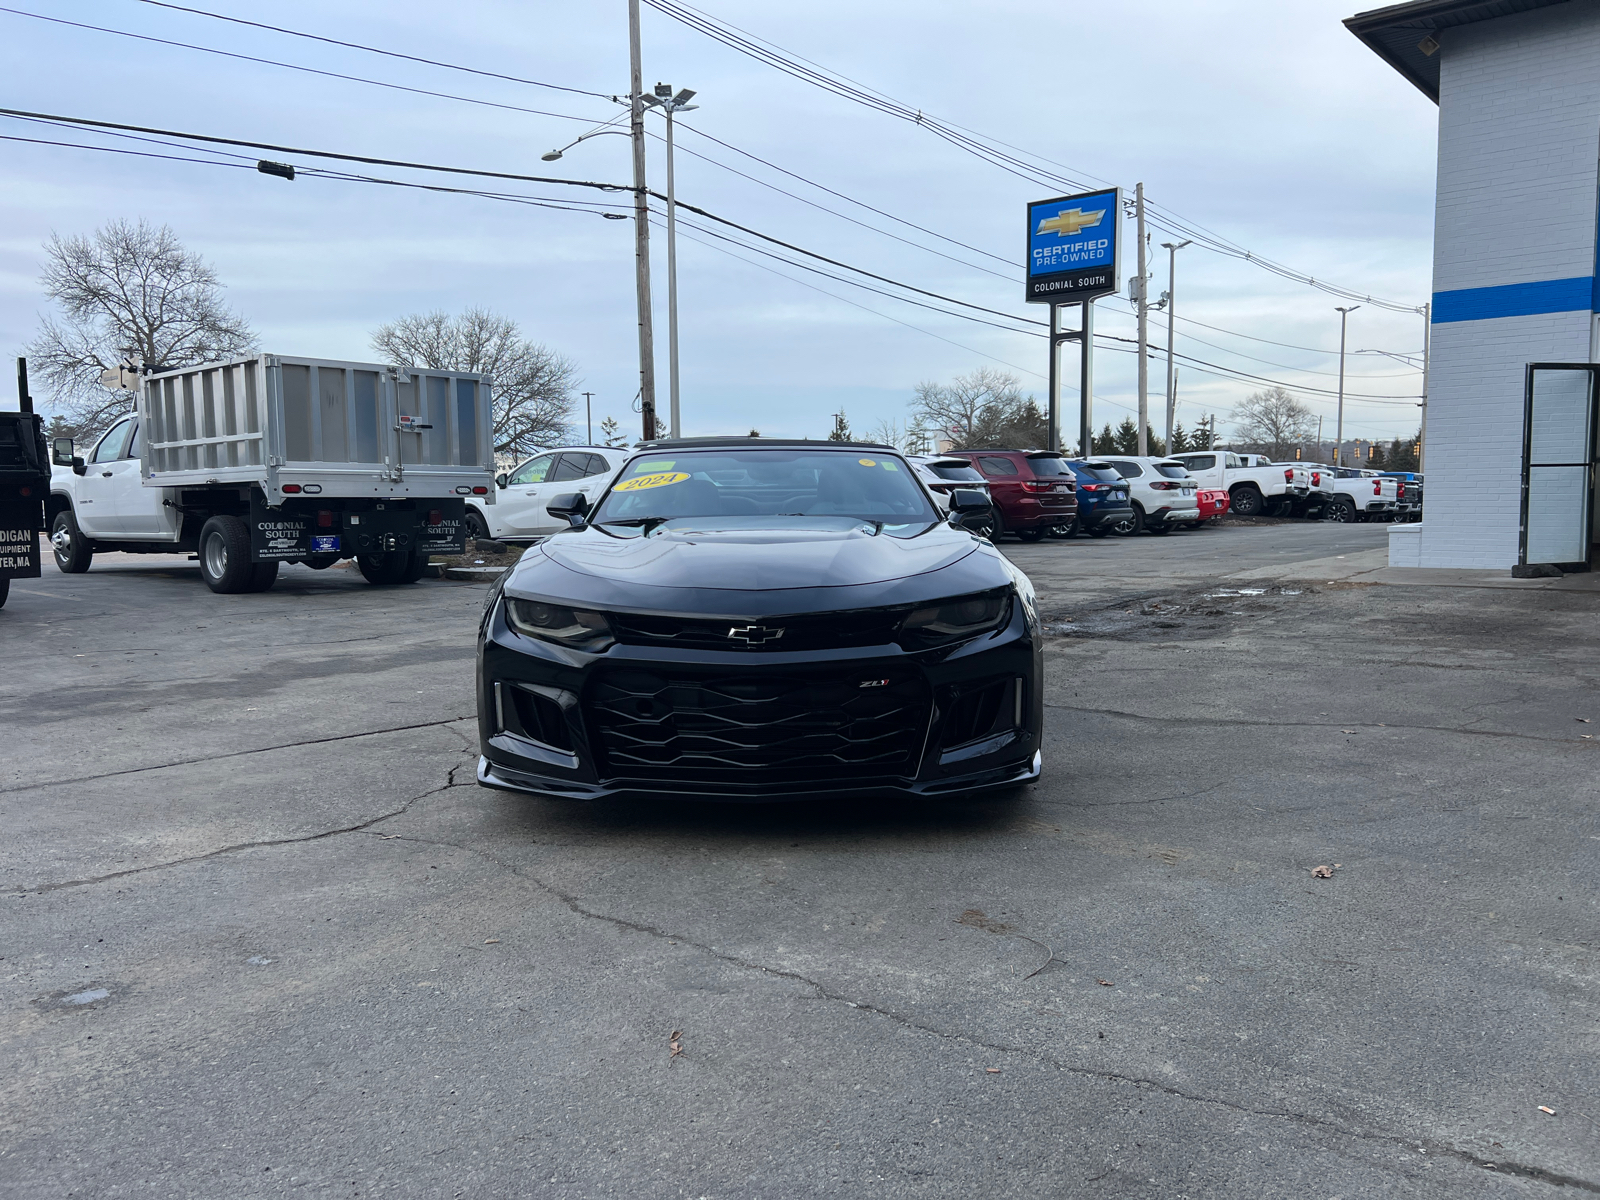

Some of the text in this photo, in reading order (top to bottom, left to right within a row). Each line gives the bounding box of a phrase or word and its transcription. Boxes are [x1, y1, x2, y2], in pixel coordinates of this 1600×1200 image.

[1033, 238, 1108, 258] CERTIFIED
[1036, 249, 1104, 267] PRE-OWNED
[1034, 275, 1106, 292] COLONIAL SOUTH
[624, 473, 678, 490] 2024
[258, 522, 306, 530] COLONIAL
[427, 527, 455, 535] SOUTH
[0, 530, 31, 542] DIGAN
[859, 679, 889, 688] ZL1
